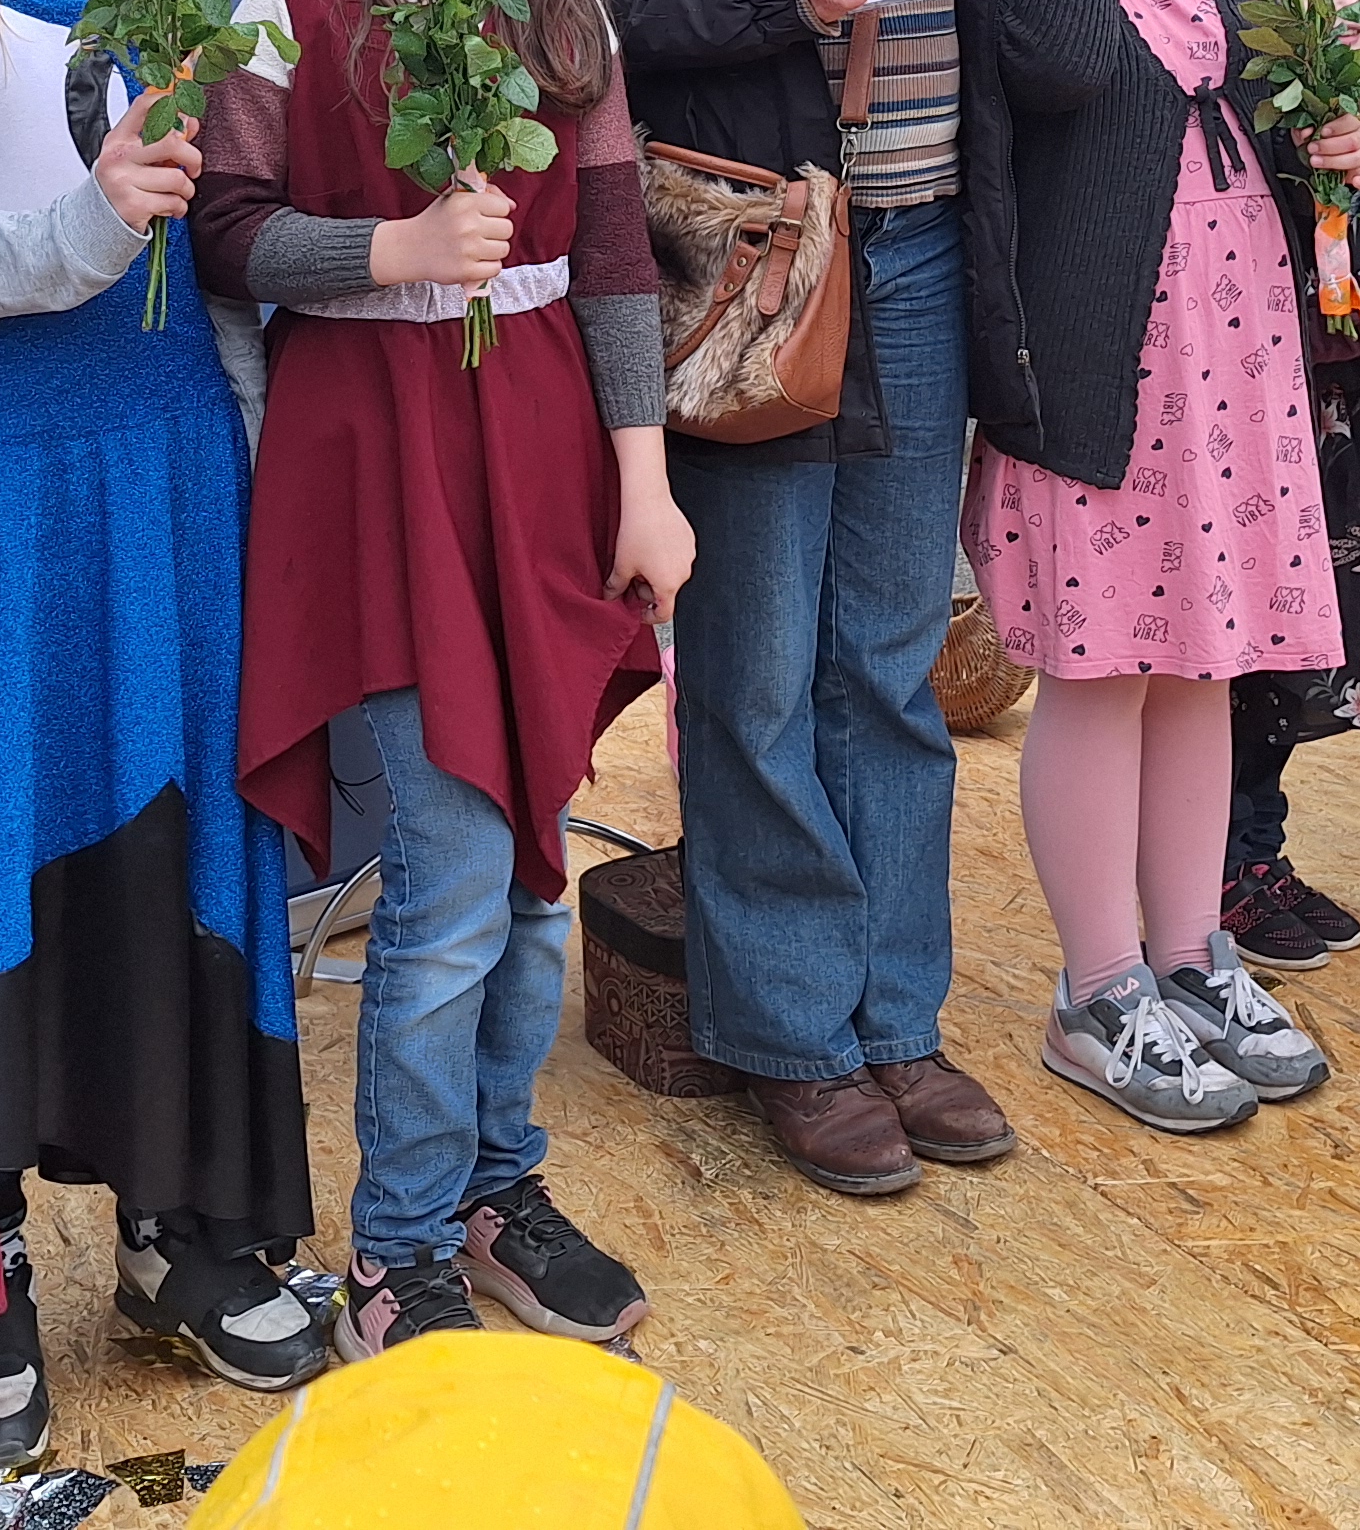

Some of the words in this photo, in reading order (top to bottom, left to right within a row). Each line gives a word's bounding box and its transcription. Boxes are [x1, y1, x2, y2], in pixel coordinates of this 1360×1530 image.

[1165, 242, 1180, 278] VIBES
[1267, 297, 1294, 313] VIBES
[1160, 392, 1176, 426] VIBES
[1275, 448, 1303, 465] VIBES
[1132, 478, 1168, 498] VIBES
[1236, 498, 1276, 528] VIBES
[1297, 504, 1313, 542] VIBES
[1092, 526, 1131, 556] VIBES
[1161, 541, 1174, 573] VIBES
[1269, 598, 1306, 615] VIBES
[1005, 636, 1036, 656] VIBES
[1133, 625, 1170, 644] VIBES
